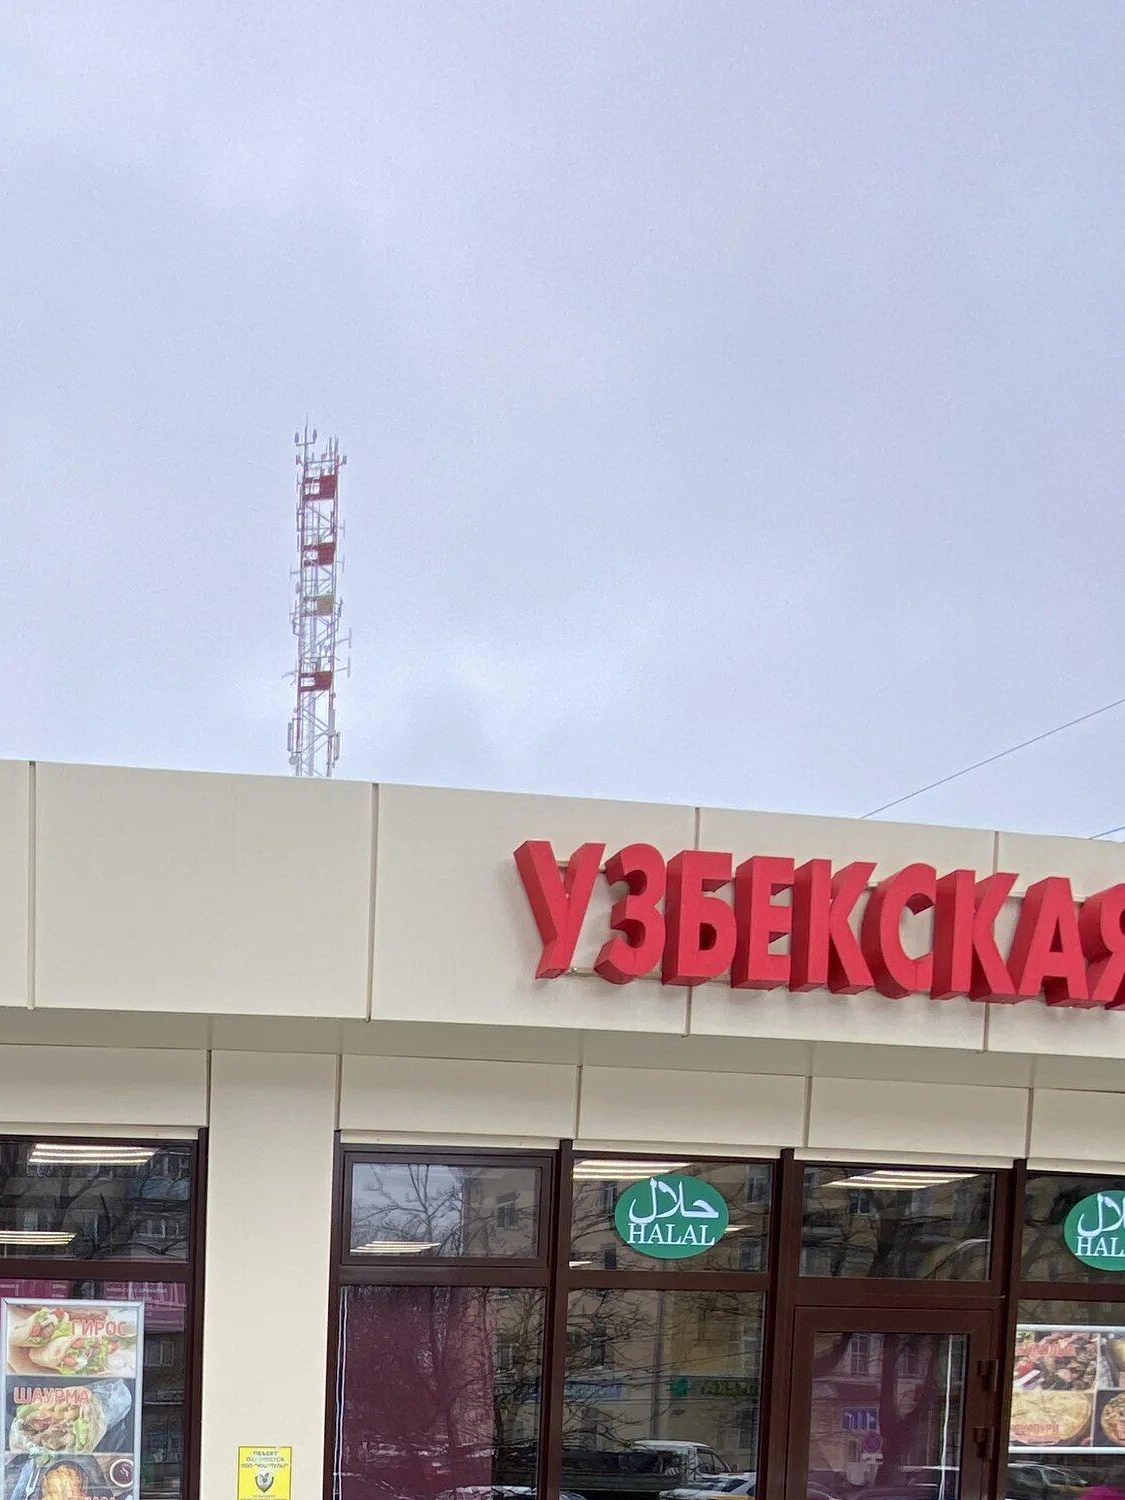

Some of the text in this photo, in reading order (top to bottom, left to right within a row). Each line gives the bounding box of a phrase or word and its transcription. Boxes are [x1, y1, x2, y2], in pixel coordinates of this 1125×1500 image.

[627, 1223, 715, 1246] HALAL
[71, 1319, 127, 1337] ГИРОС
[13, 1387, 90, 1405] ШАУРМА
